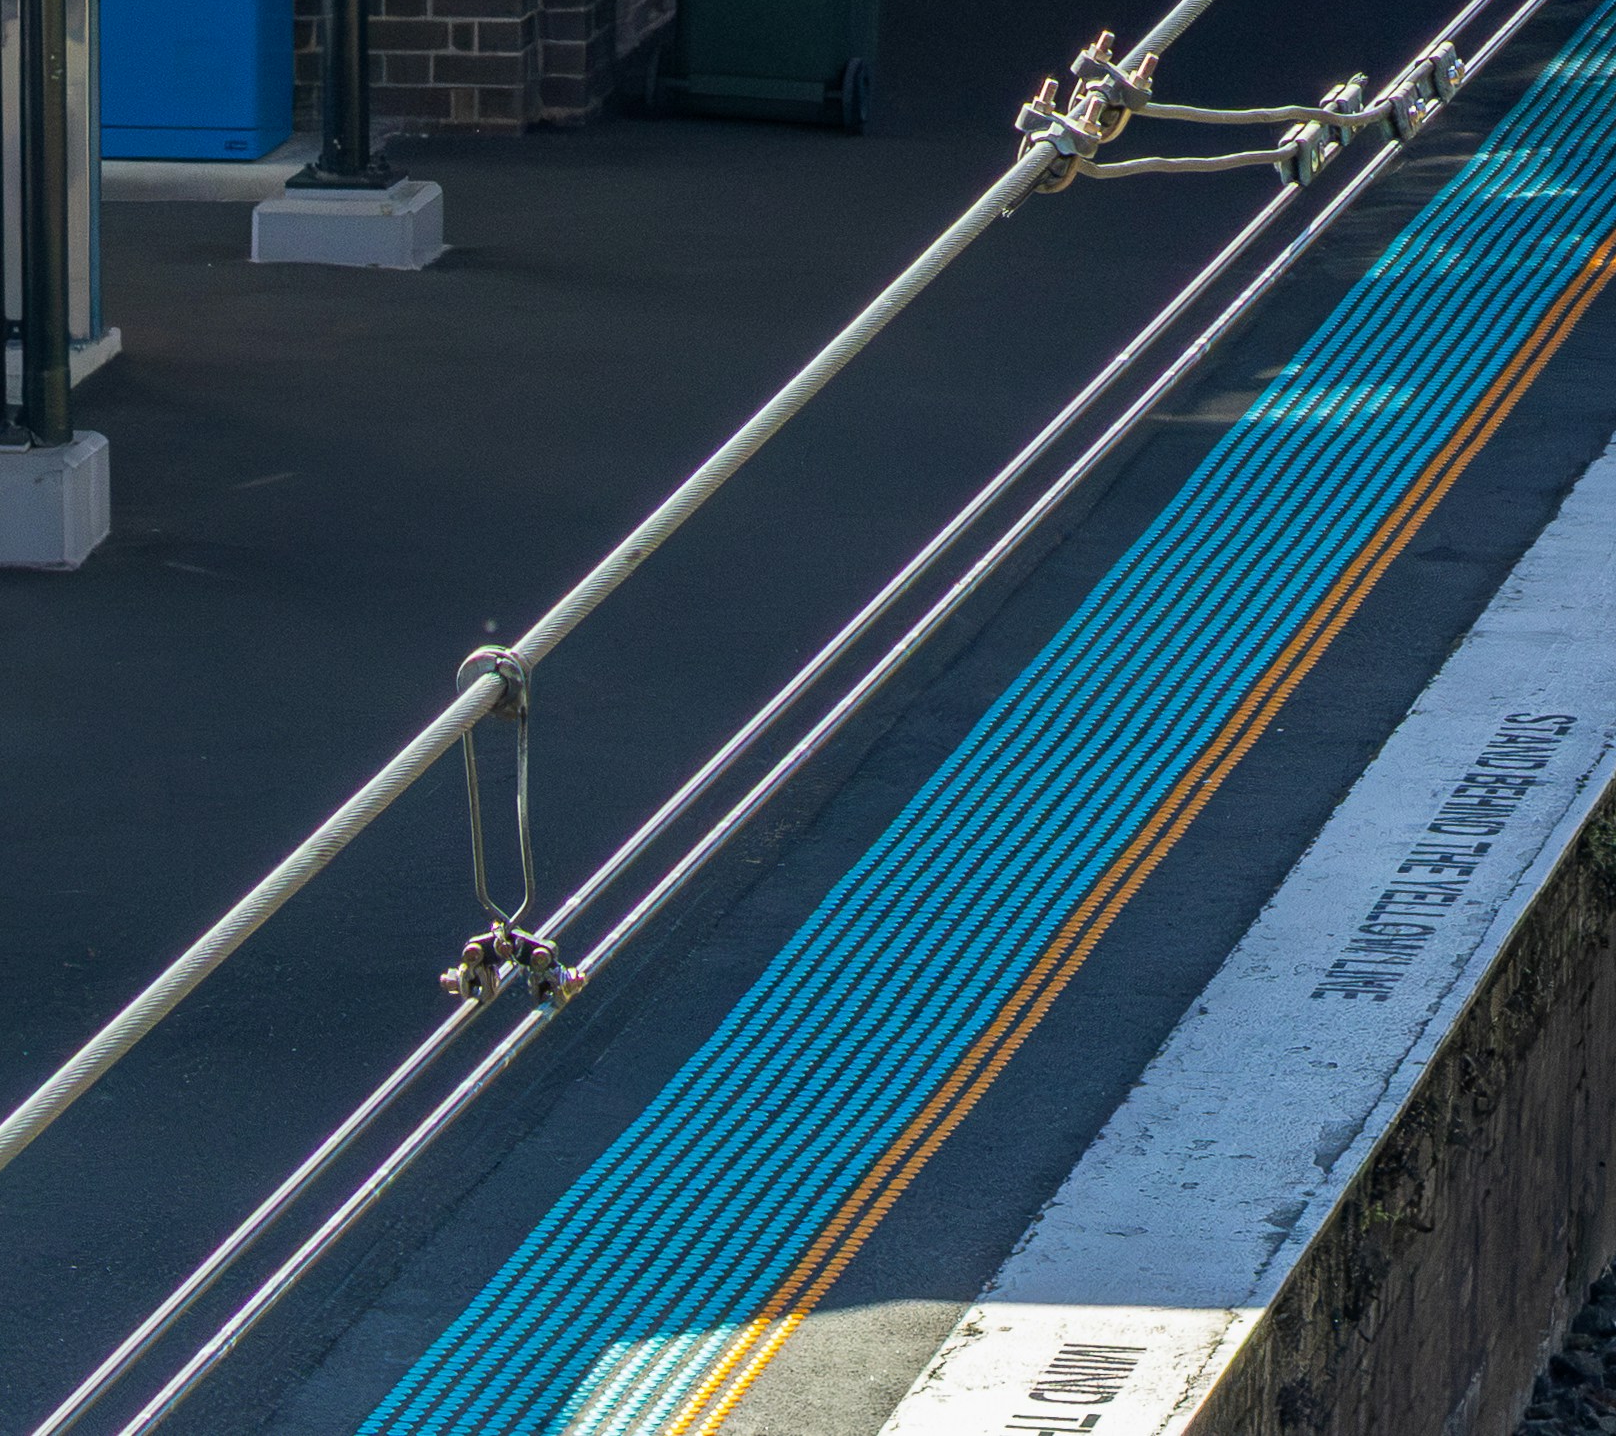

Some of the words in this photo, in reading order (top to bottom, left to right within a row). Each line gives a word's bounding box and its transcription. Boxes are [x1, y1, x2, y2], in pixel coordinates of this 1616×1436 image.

[1474, 712, 1578, 771] STAND
[1427, 772, 1536, 837] BEHIND
[1396, 841, 1492, 877] THE
[1340, 879, 1471, 957] YELLOW
[1309, 958, 1413, 1002] LINE
[1028, 1343, 1147, 1405] MIND
